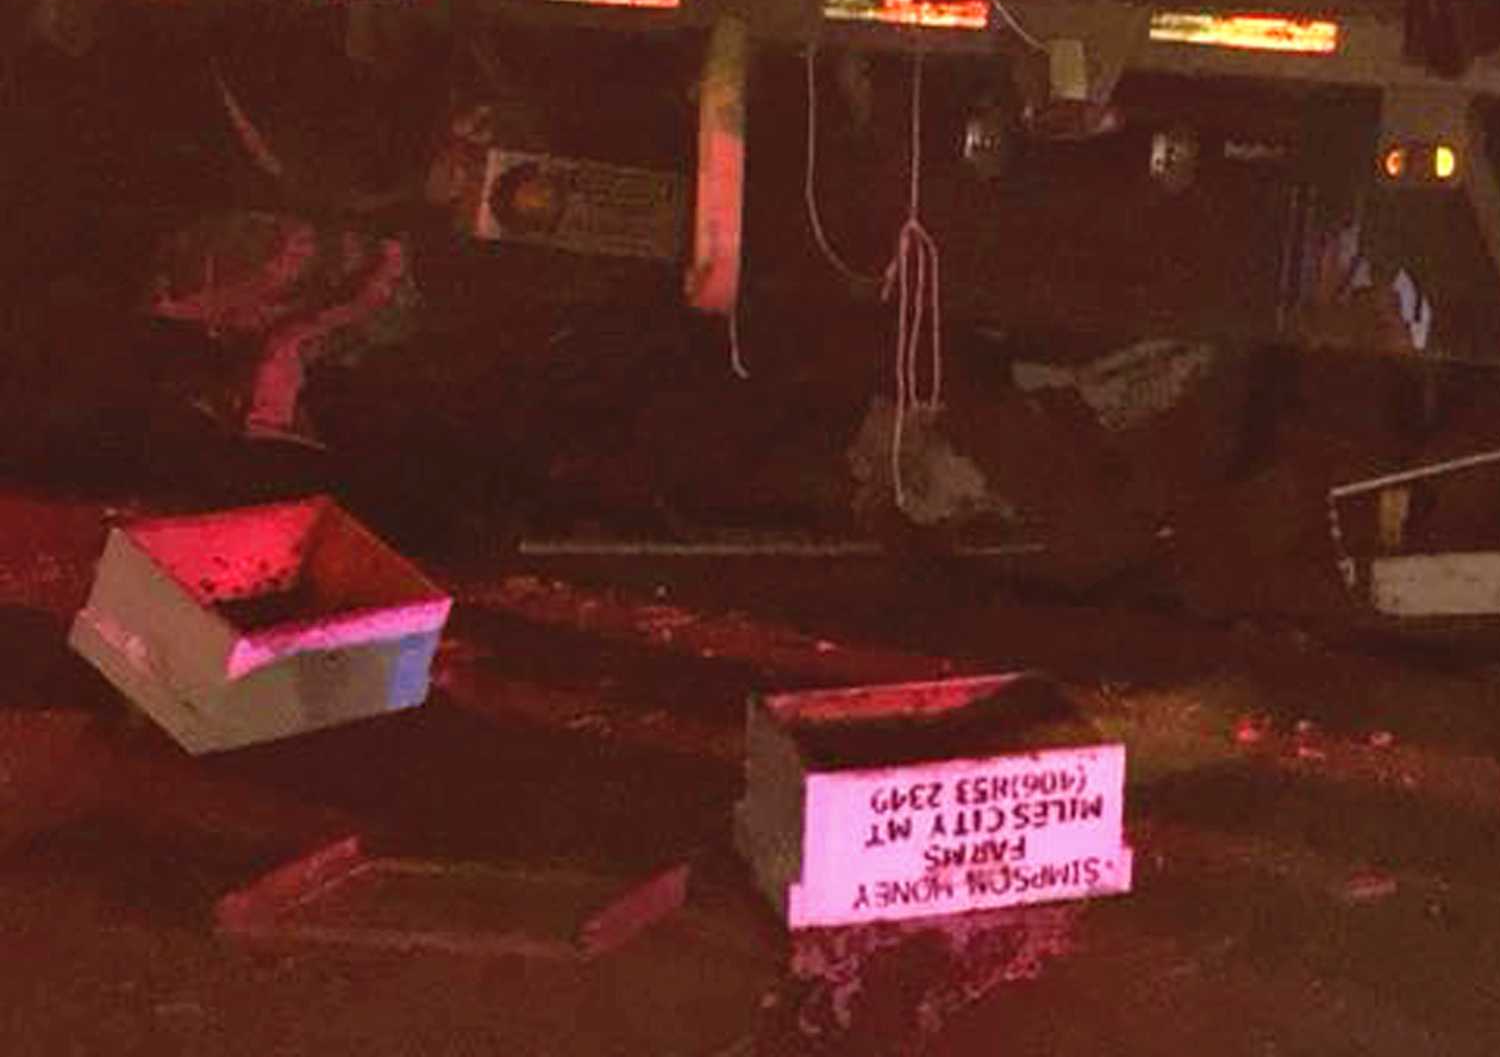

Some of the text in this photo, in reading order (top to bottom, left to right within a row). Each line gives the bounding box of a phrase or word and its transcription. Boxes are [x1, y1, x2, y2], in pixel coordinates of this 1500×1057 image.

[870, 783, 942, 814] 2349
[864, 795, 1103, 848] MILES CITY MT
[923, 836, 1027, 873] FARMS
[852, 856, 1101, 911] SIMPSON HONEY
